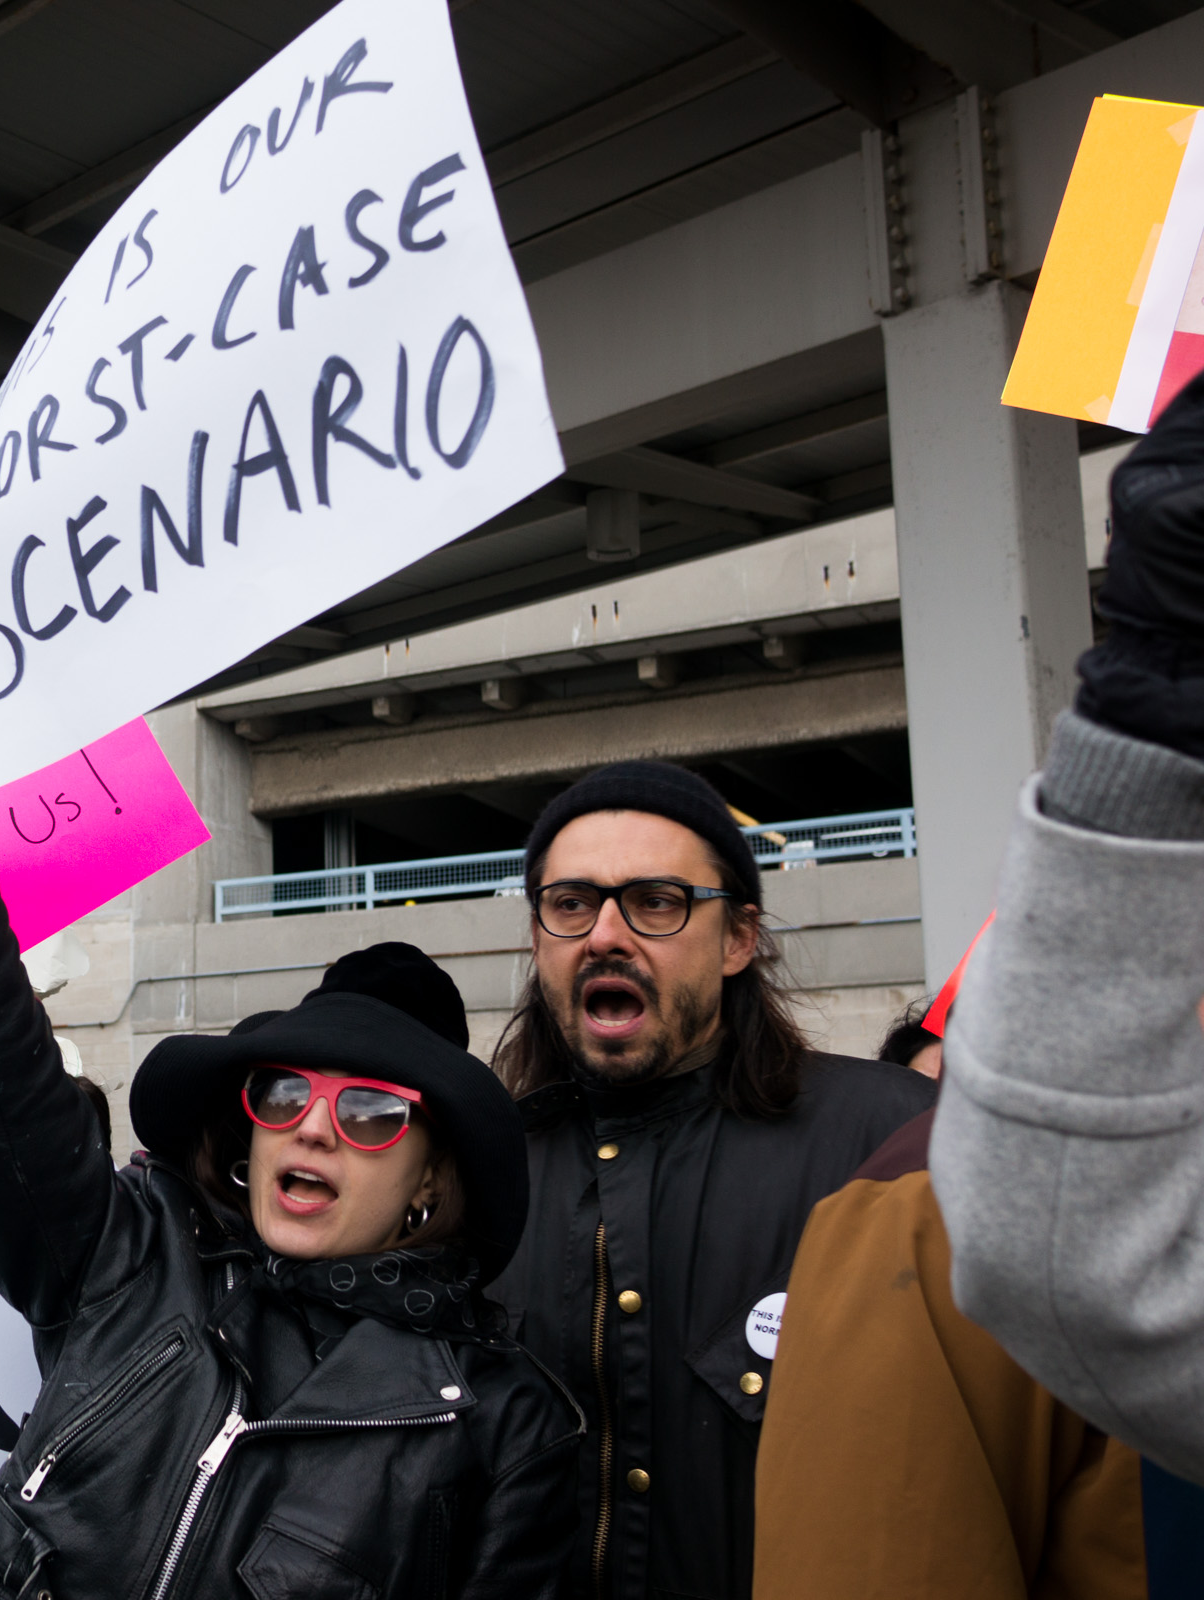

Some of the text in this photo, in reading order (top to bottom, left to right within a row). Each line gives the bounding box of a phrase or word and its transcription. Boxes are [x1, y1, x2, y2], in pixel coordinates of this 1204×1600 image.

[103, 208, 160, 305] IS
[220, 37, 394, 194] OUR
[751, 1308, 774, 1321] THIS
